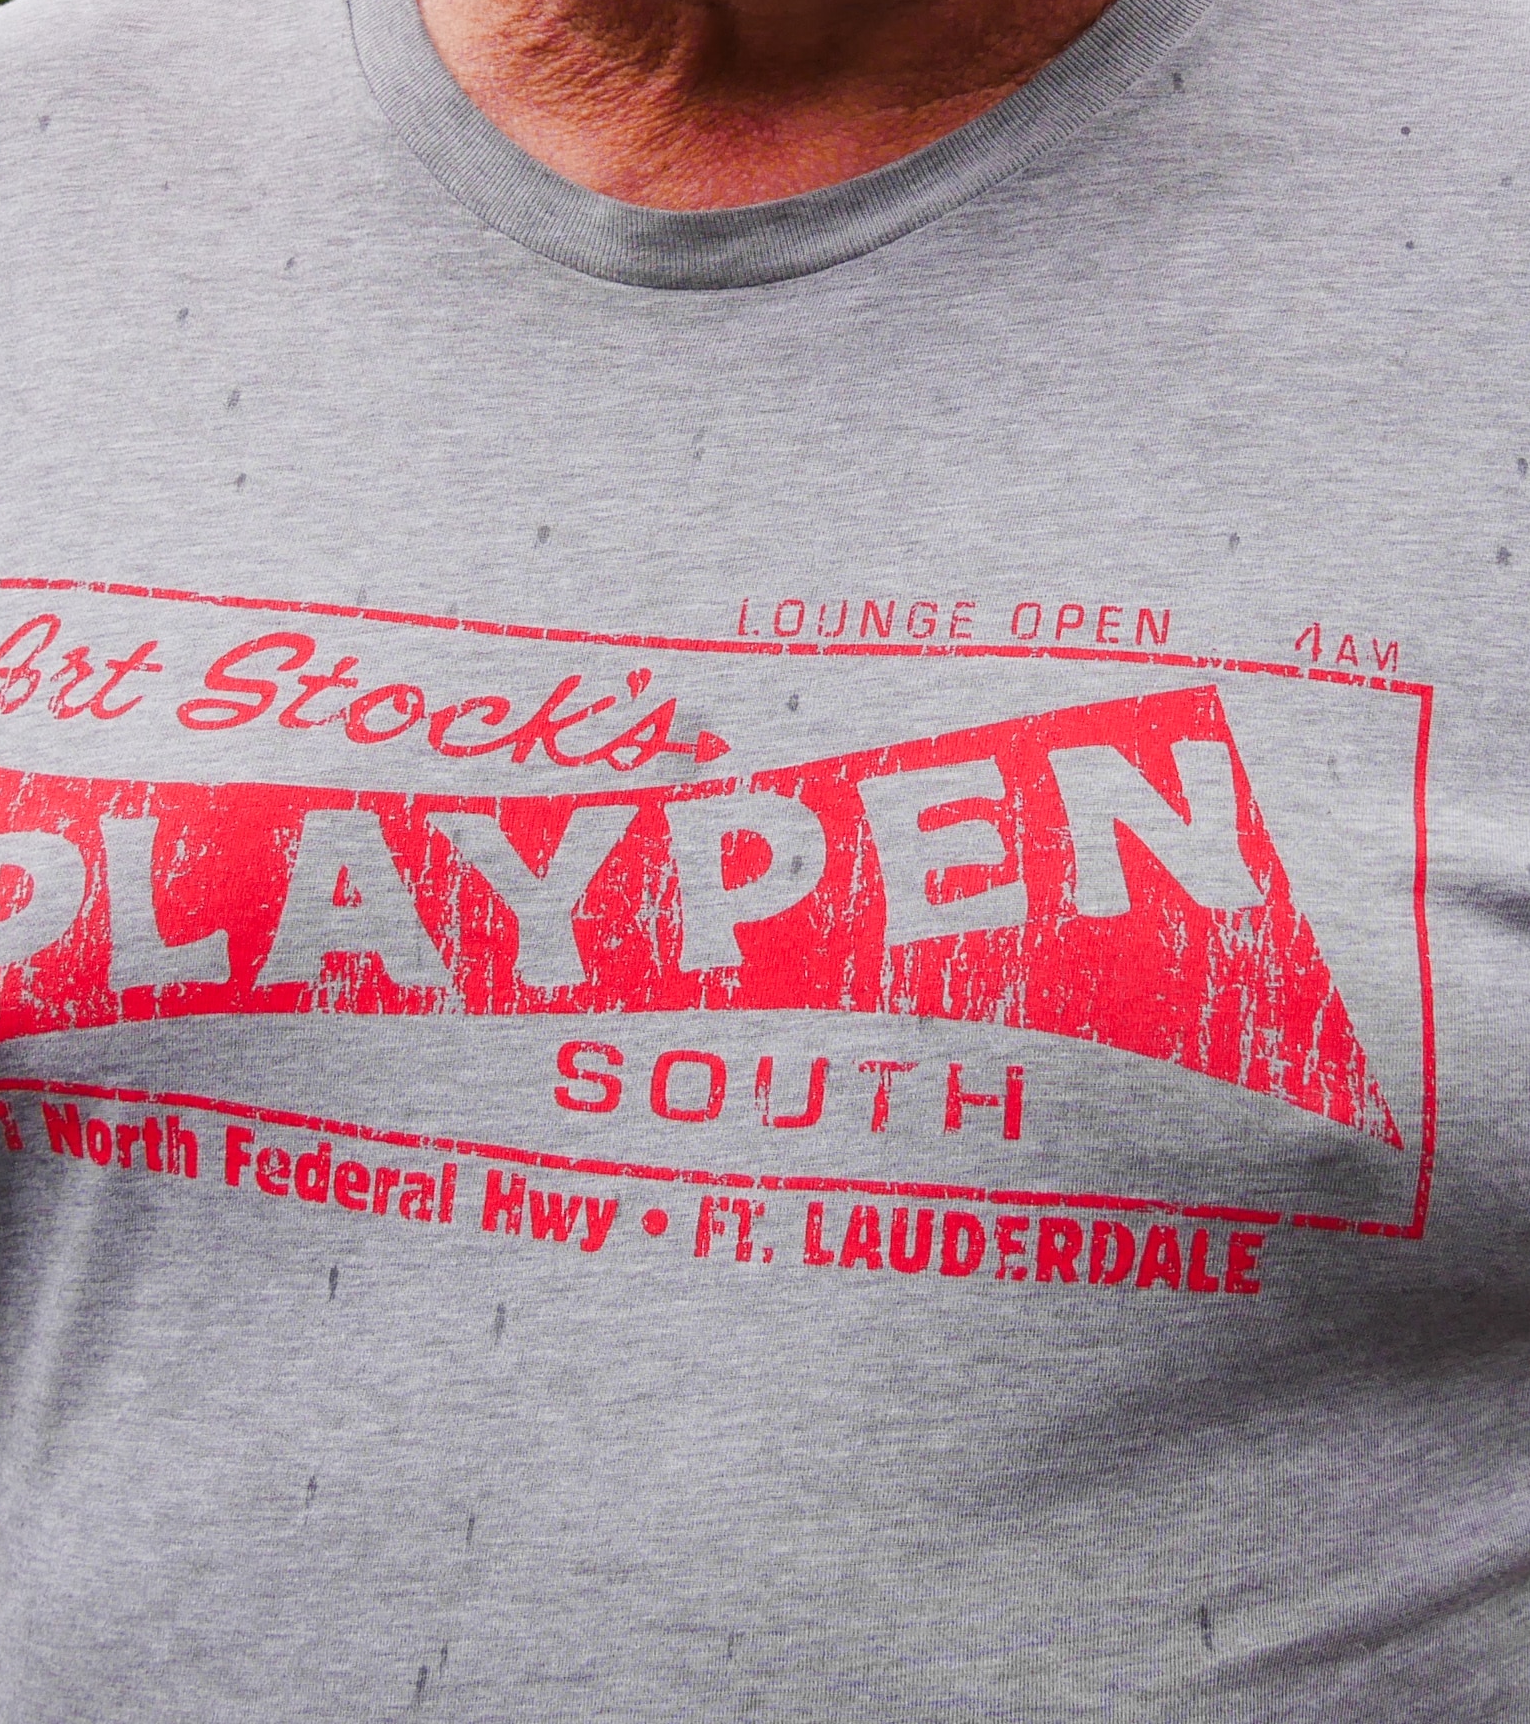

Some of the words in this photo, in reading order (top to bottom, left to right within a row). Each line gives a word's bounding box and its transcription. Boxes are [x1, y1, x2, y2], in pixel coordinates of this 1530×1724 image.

[736, 597, 977, 640] LOUNGE
[1010, 601, 1171, 646] OPEN
[176, 630, 679, 772] Stock's
[554, 1039, 1024, 1141] SOUTH
[41, 1100, 199, 1180] North
[224, 1124, 458, 1224] Federal
[481, 1168, 619, 1253] Hwy
[802, 1200, 1266, 1295] LAUDERDALE
